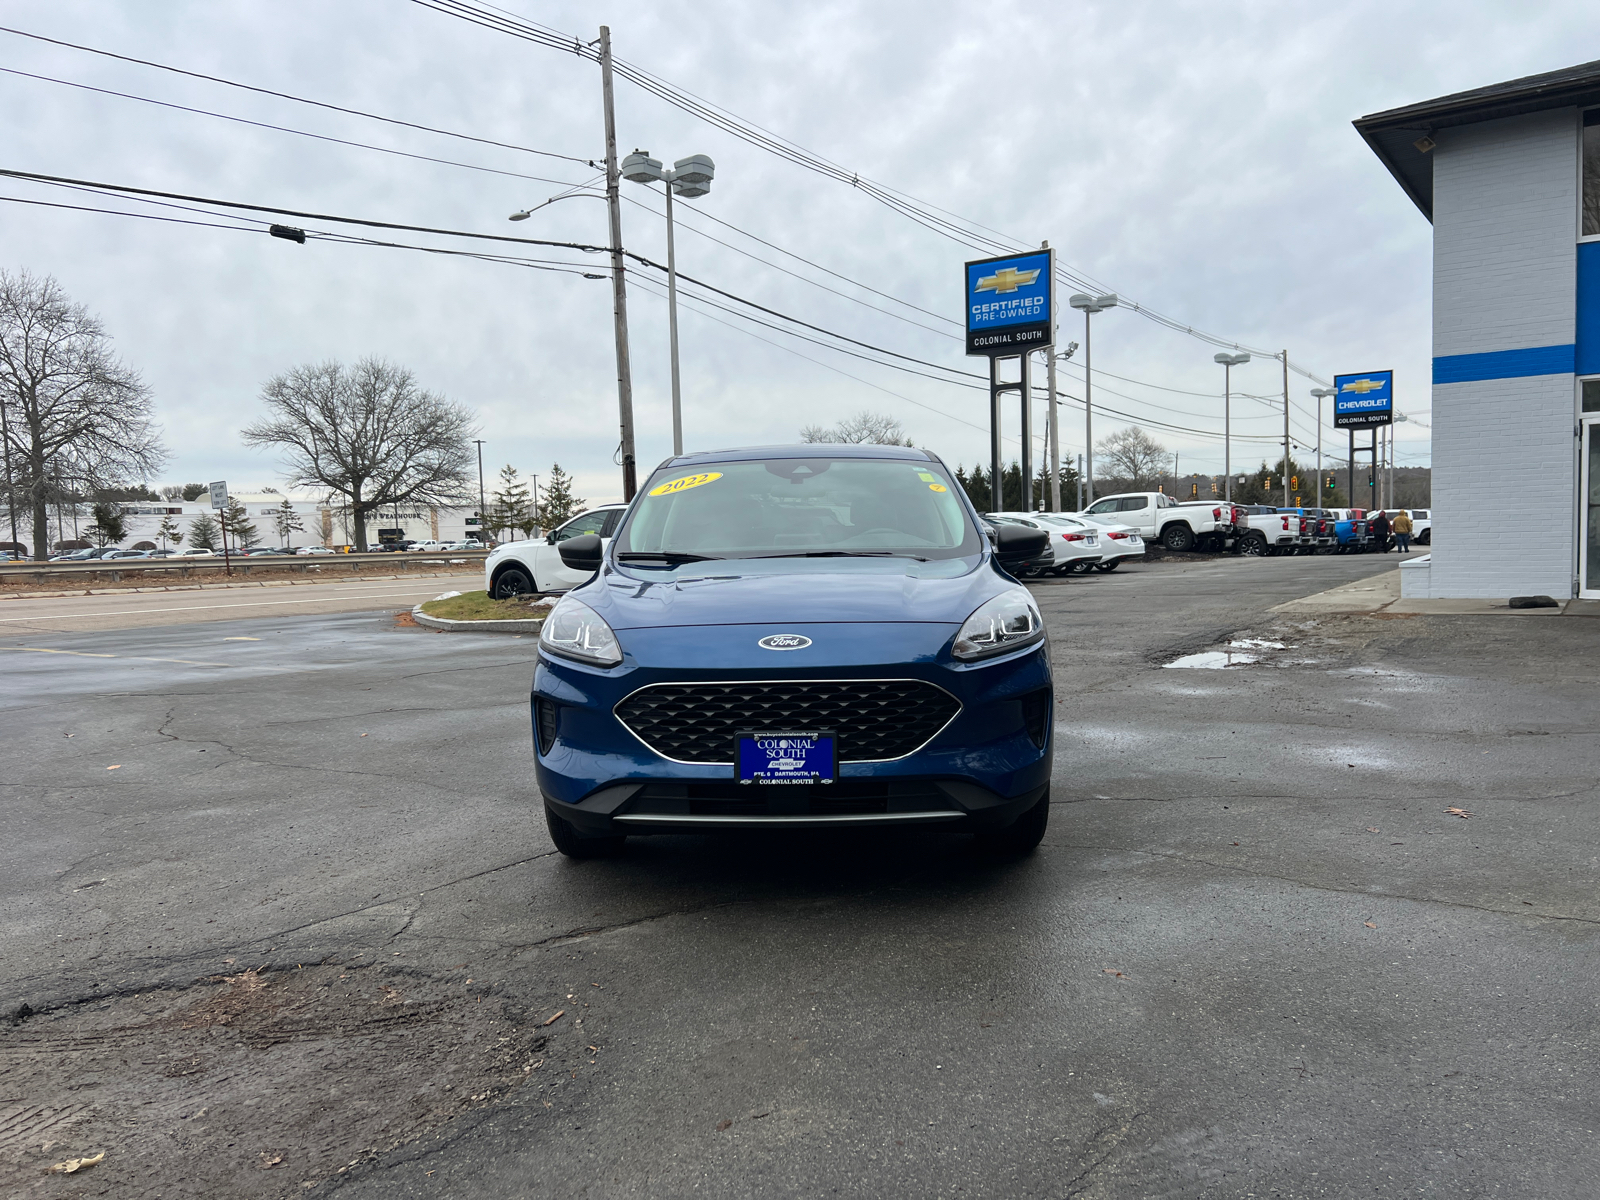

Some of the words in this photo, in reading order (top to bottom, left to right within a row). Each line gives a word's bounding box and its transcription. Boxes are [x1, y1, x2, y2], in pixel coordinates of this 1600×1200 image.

[972, 296, 1044, 314] CERTIFIED
[975, 306, 1041, 322] PRE-OWNED
[974, 336, 1012, 346] COLONIAL
[1016, 330, 1042, 341] SOUTH
[1338, 398, 1388, 409] CHEVROLET
[1338, 416, 1366, 424] COLONIAL
[661, 474, 709, 494] 2022
[770, 636, 800, 646] Ford
[757, 739, 815, 749] COLONIAL
[766, 749, 806, 758] SOUTH
